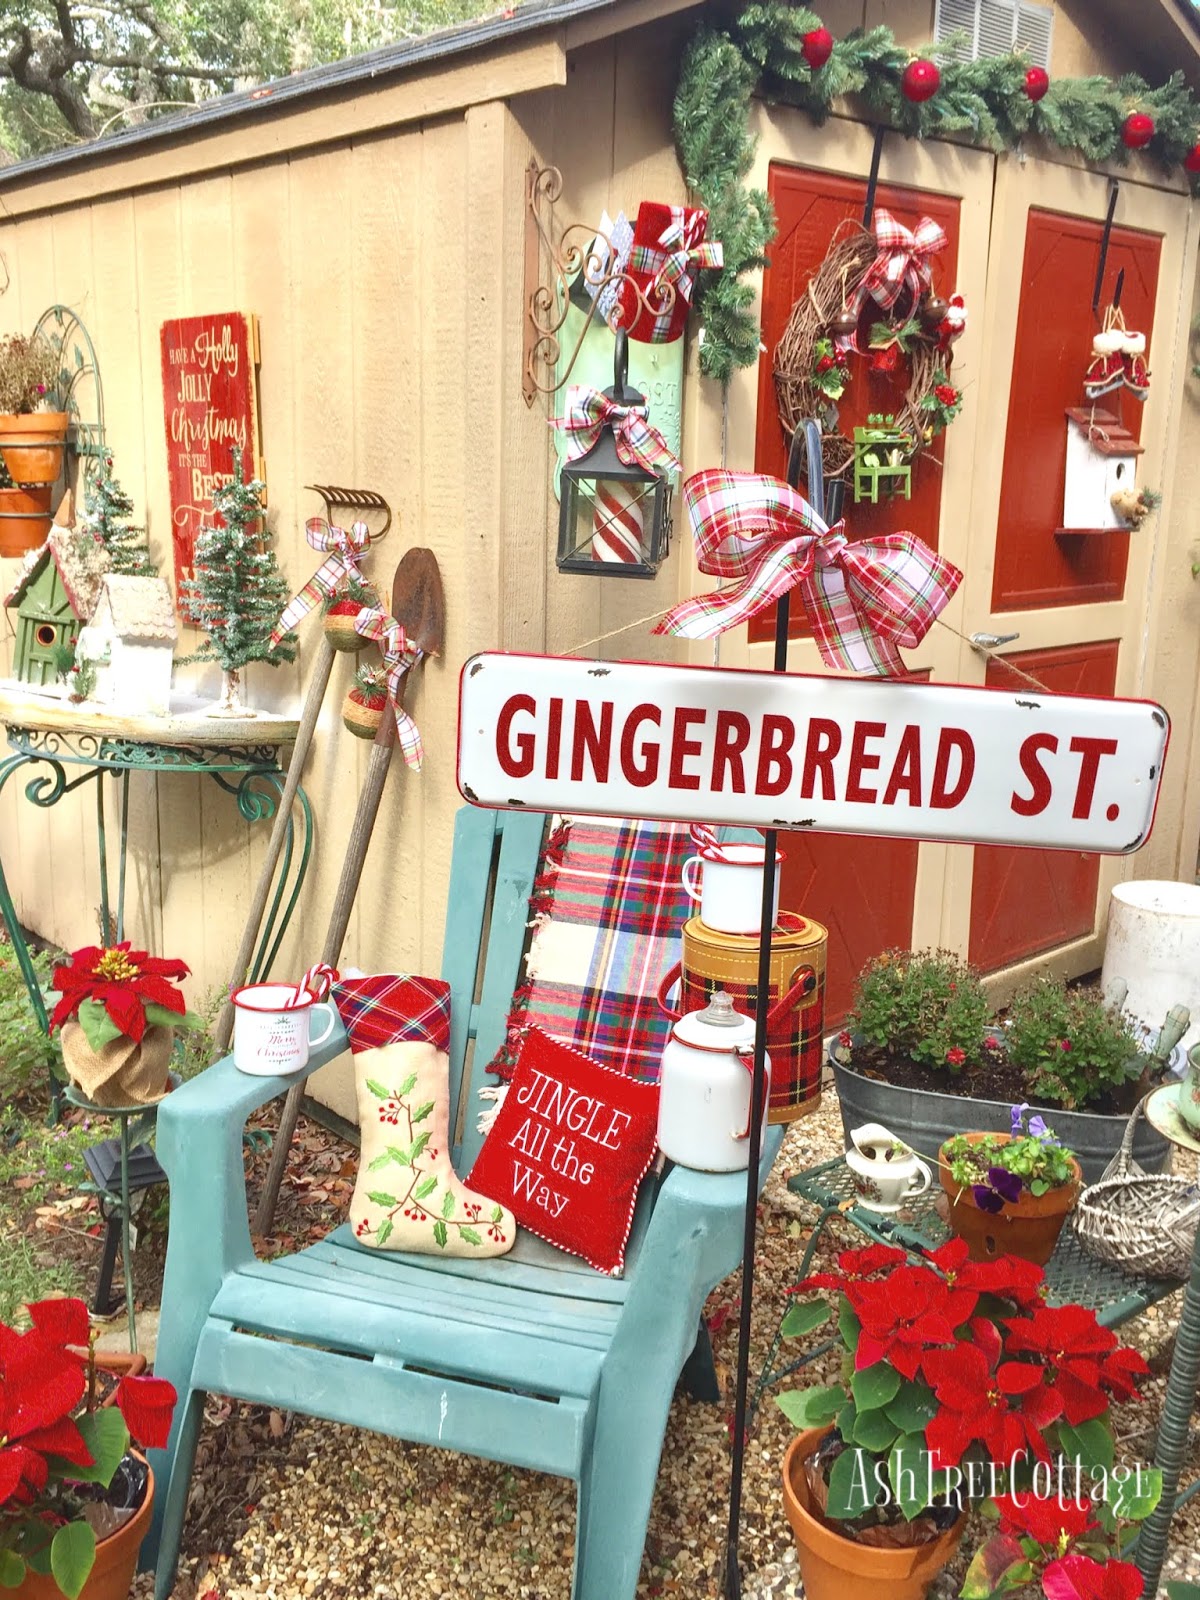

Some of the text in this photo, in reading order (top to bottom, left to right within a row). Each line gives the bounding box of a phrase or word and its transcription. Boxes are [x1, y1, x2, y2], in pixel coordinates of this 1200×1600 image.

[169, 324, 239, 378] HAVE A Holly
[177, 369, 213, 404] JOLLY
[637, 381, 677, 407] OST
[171, 405, 247, 453] Christmas
[178, 453, 207, 468] IT'S THE
[495, 693, 1121, 823] GINGERBREAD ST.
[516, 1068, 632, 1151] JINGLE
[508, 1117, 595, 1185] All the
[512, 1160, 570, 1218] Way
